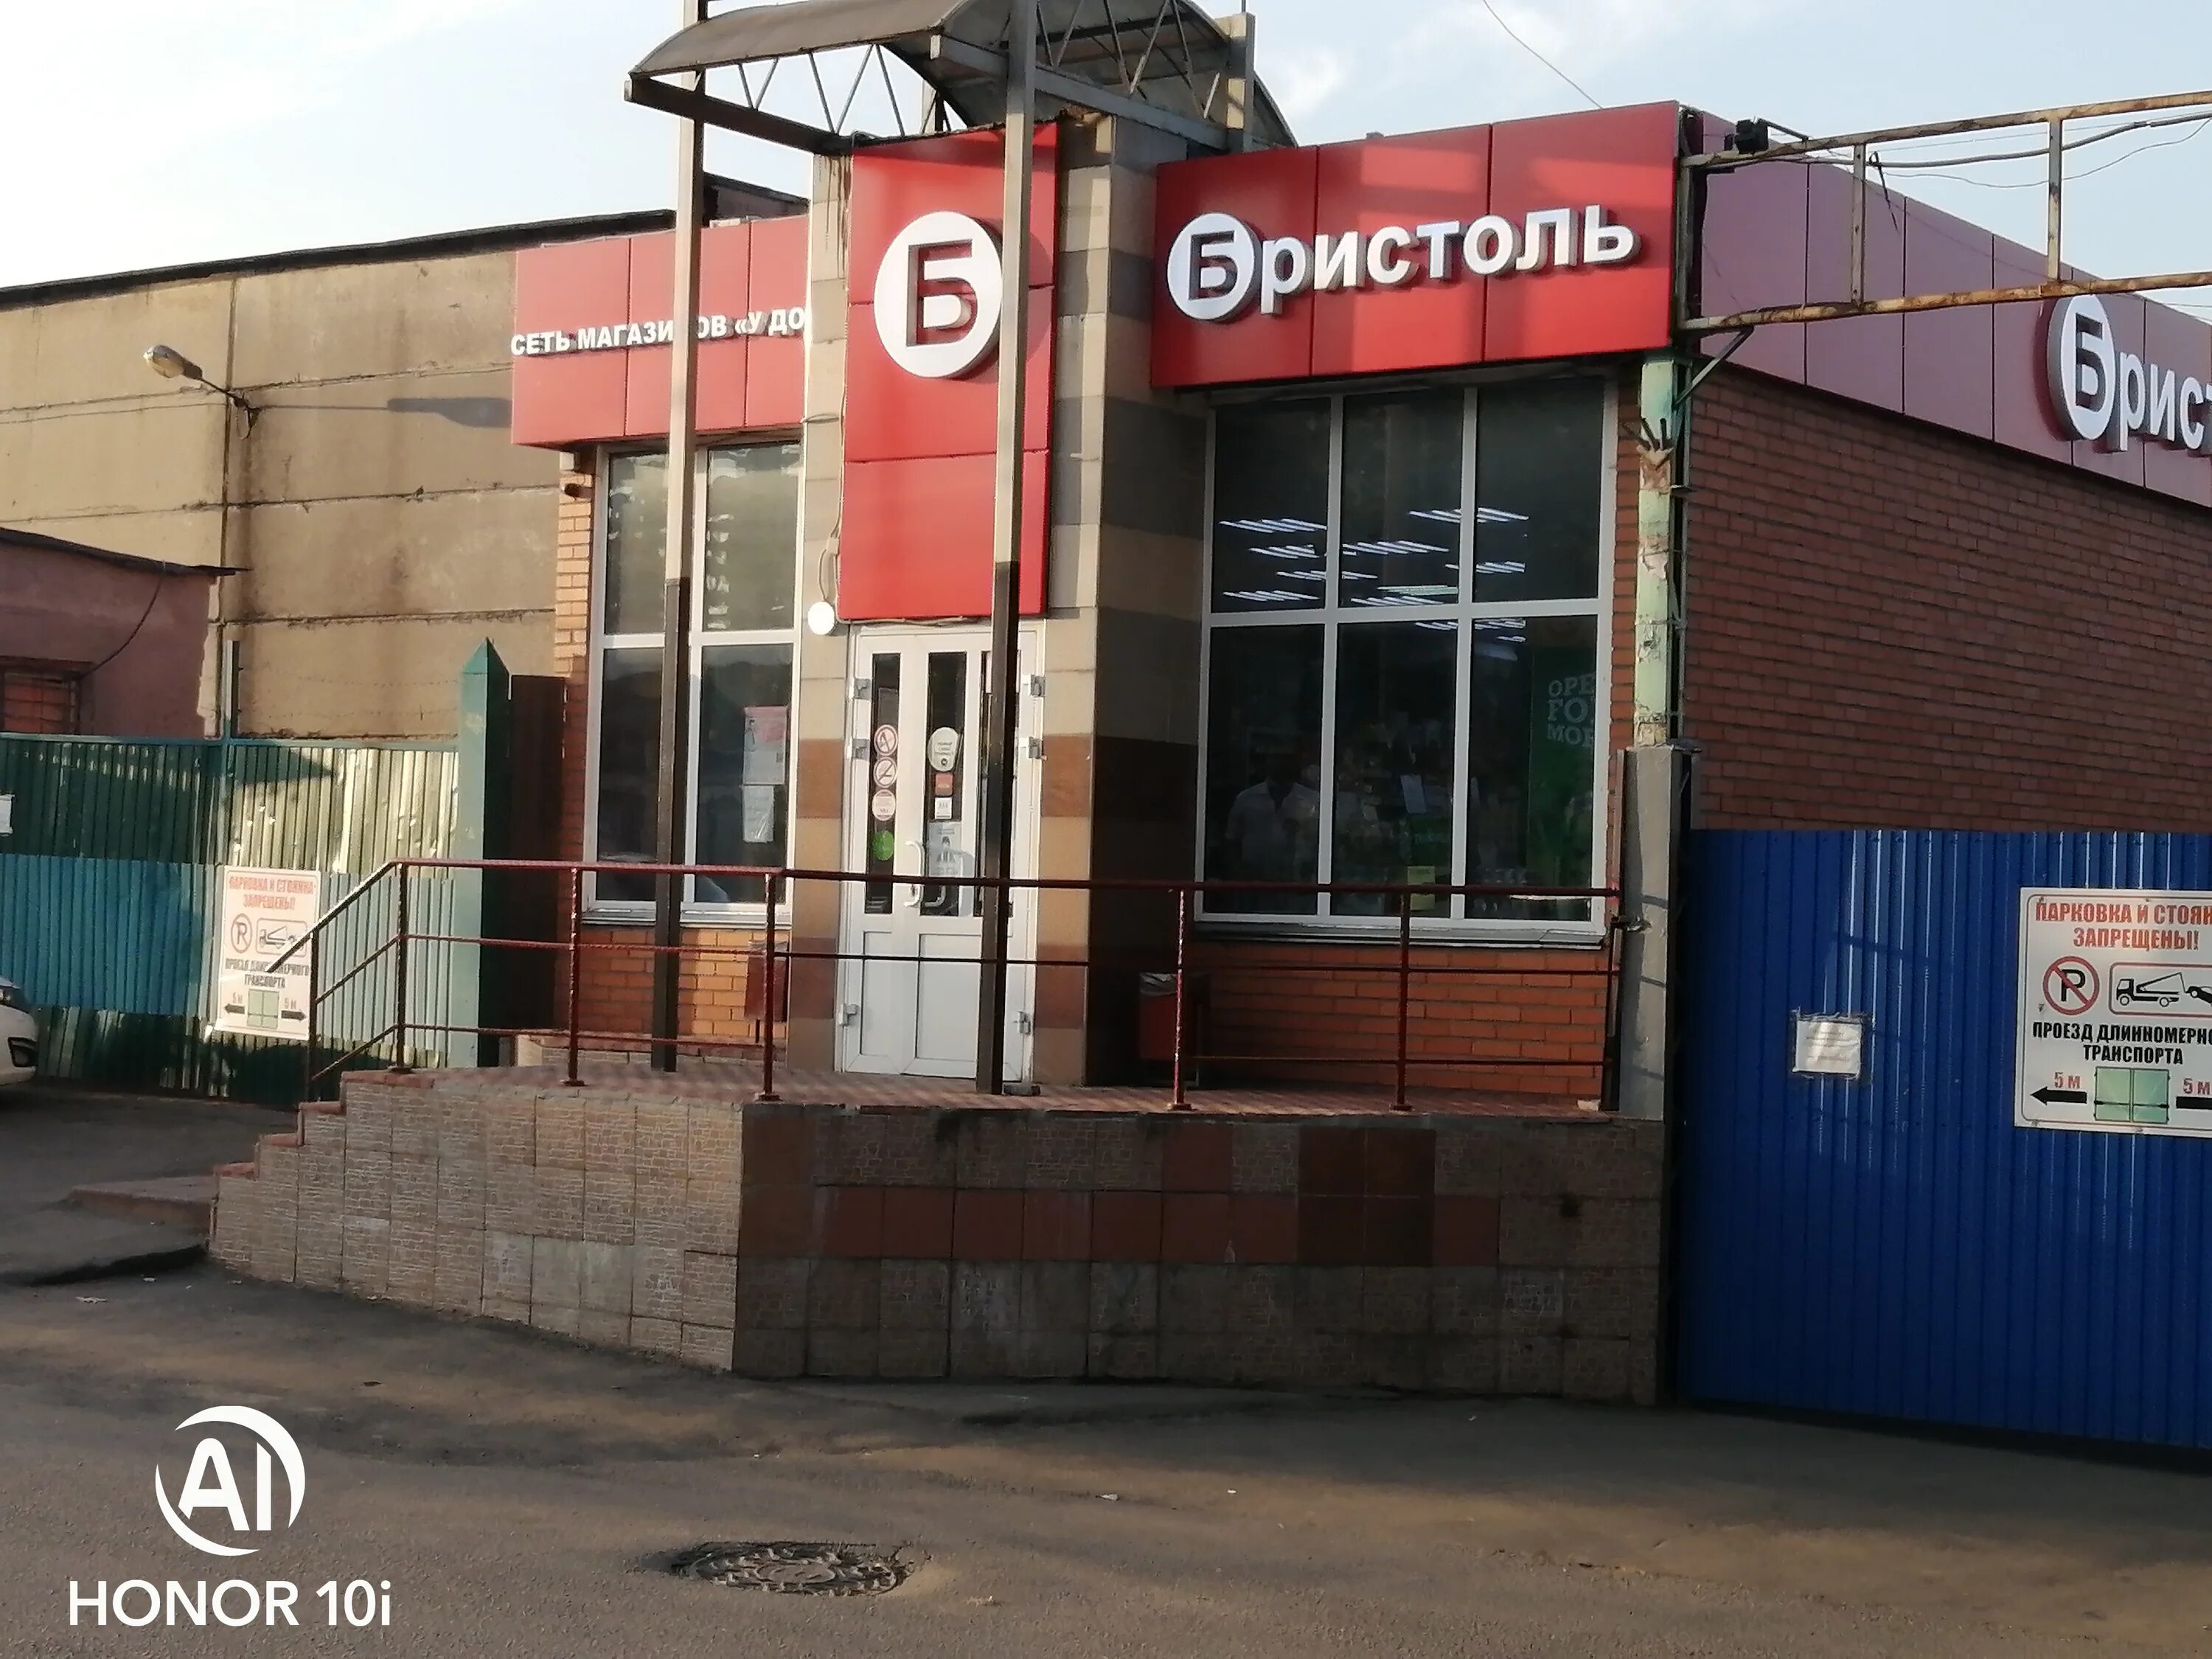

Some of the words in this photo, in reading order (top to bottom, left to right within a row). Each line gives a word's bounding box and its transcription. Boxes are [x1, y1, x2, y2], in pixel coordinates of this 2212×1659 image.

[1184, 204, 1636, 316] Бристоль
[510, 330, 570, 355] СЕТЬ
[577, 314, 727, 349] МАГАЗИОВ
[1548, 696, 1595, 723] FO
[2035, 901, 2131, 923] ПАРКОВКА
[2137, 903, 2149, 925] И
[2073, 927, 2199, 951] ЗАПРЕЩЕНЫ!
[2033, 1022, 2093, 1043] ПРОЕЗД
[2083, 1044, 2183, 1065] ТРАНСПОРТА
[2053, 1071, 2065, 1088] 5
[2183, 1077, 2194, 1095] 5
